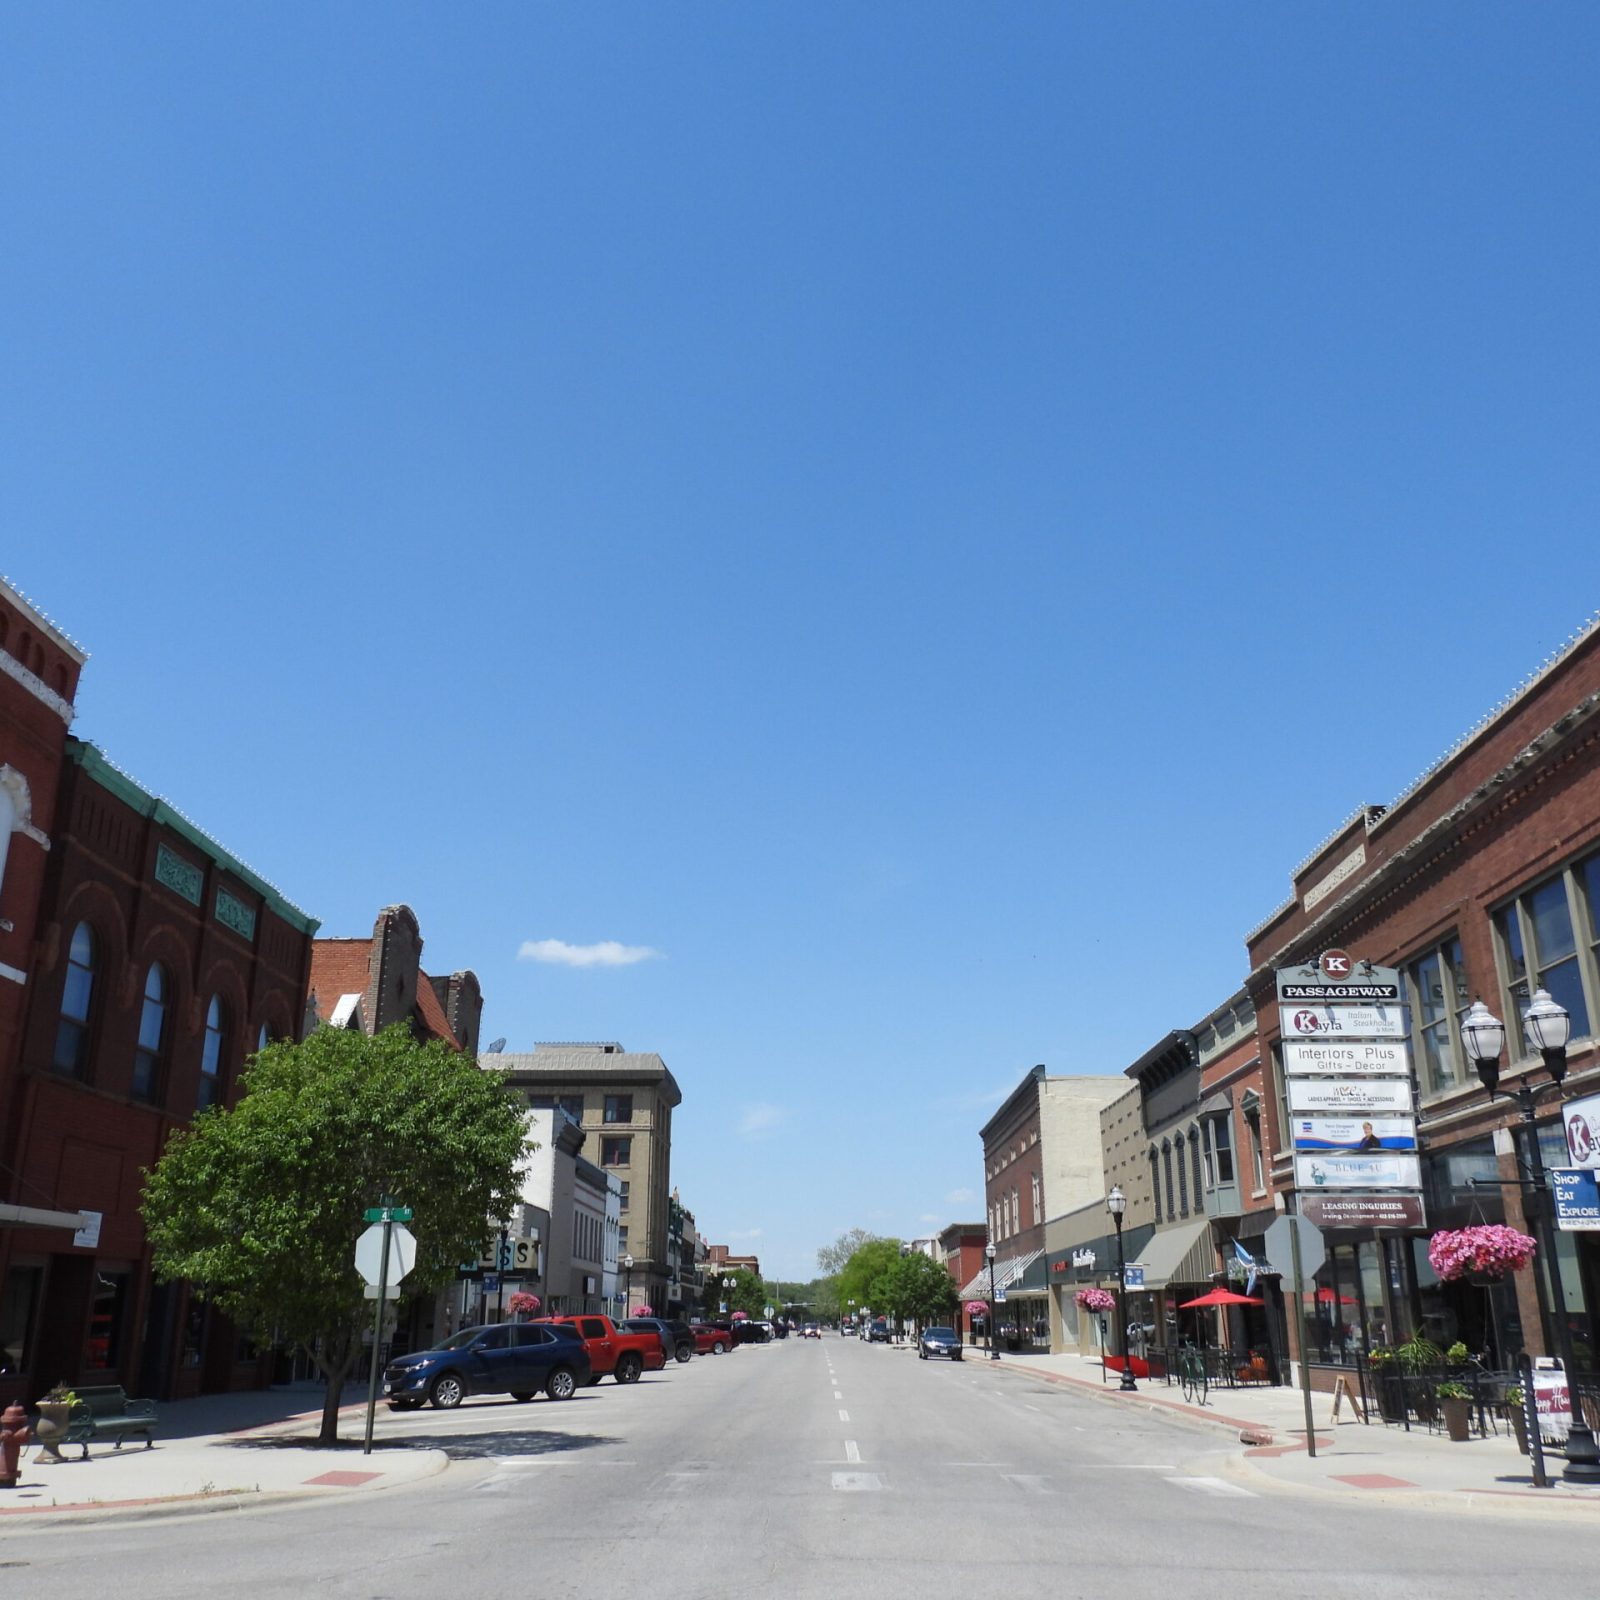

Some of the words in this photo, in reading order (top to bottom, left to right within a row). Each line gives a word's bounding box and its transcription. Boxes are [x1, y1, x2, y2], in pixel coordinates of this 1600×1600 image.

[1325, 957, 1347, 971] K
[1285, 986, 1393, 997] PASSAGEWAY
[1347, 1010, 1372, 1019] Italian
[1298, 1012, 1343, 1033] Kayla
[1353, 1019, 1395, 1027] Steakhouse
[1298, 1048, 1354, 1060] Interiors
[1365, 1047, 1395, 1059] Plus
[1317, 1061, 1343, 1070] Gifts
[1355, 1061, 1386, 1070] Decor
[1322, 1202, 1357, 1210] LEASING
[1359, 1202, 1403, 1210] INQUIRIES
[1558, 1202, 1600, 1217] EXPLORE
